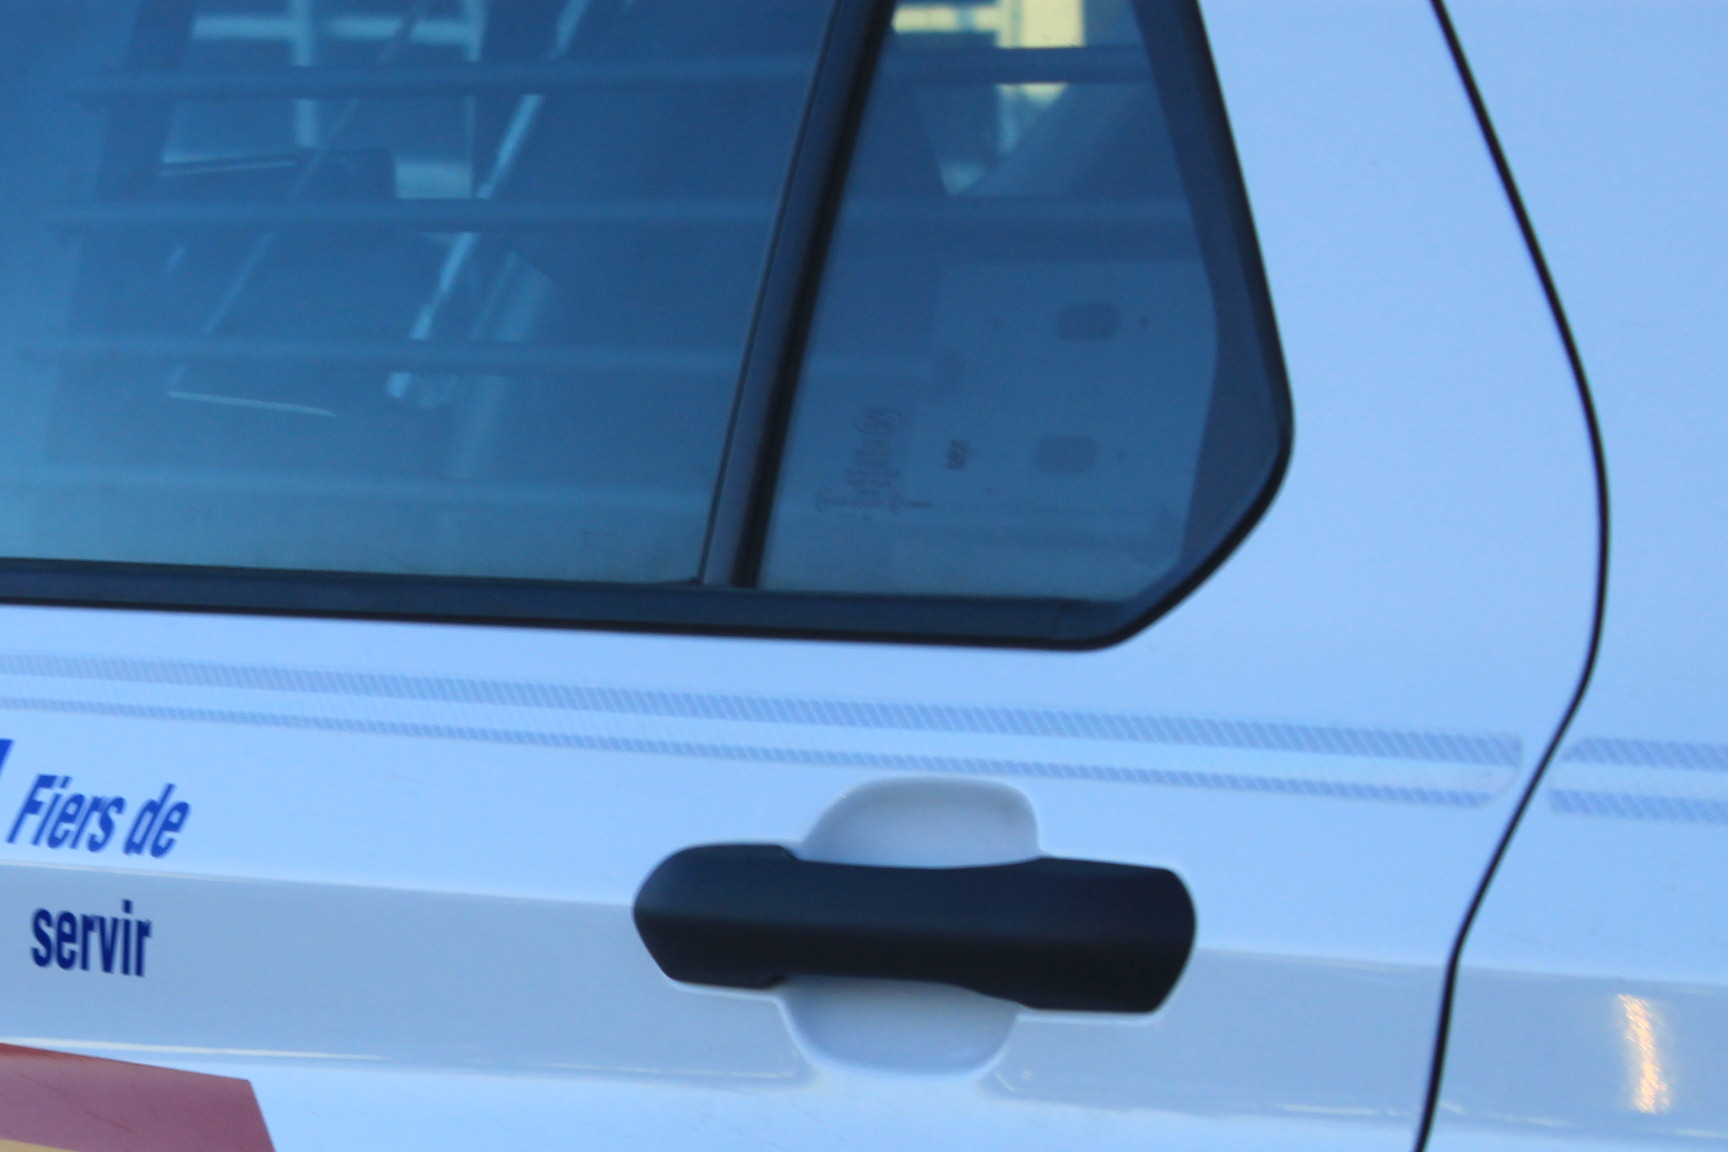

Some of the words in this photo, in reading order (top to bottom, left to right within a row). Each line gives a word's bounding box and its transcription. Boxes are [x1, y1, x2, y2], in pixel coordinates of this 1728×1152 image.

[7, 773, 126, 853] Fiers
[124, 783, 191, 858] de
[30, 900, 152, 978] servir
